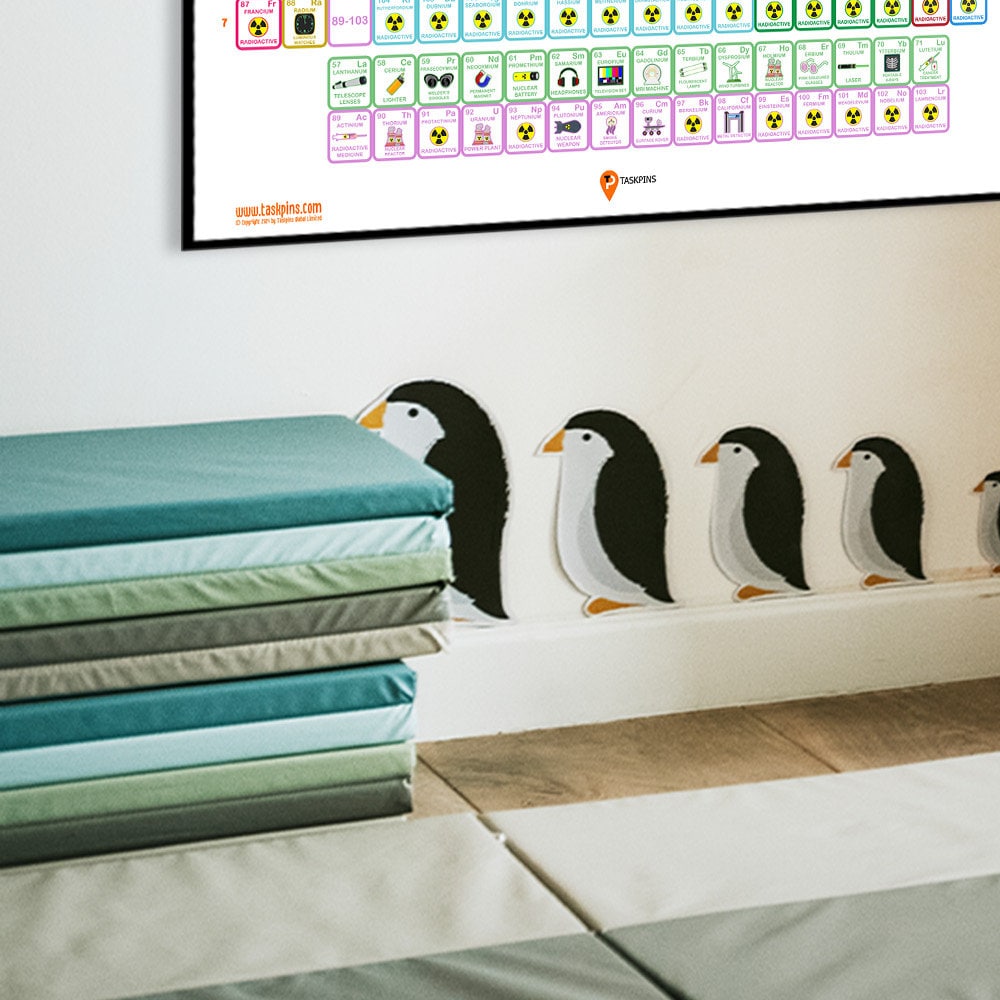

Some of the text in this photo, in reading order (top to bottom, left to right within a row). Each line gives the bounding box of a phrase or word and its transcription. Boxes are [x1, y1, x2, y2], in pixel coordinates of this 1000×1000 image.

[267, 0, 277, 8] Fr
[222, 18, 227, 27] 7
[332, 16, 368, 26] 89-103
[357, 60, 367, 68] La
[620, 175, 656, 185] TASKPINS
[235, 201, 322, 218] www.taskpins.com
